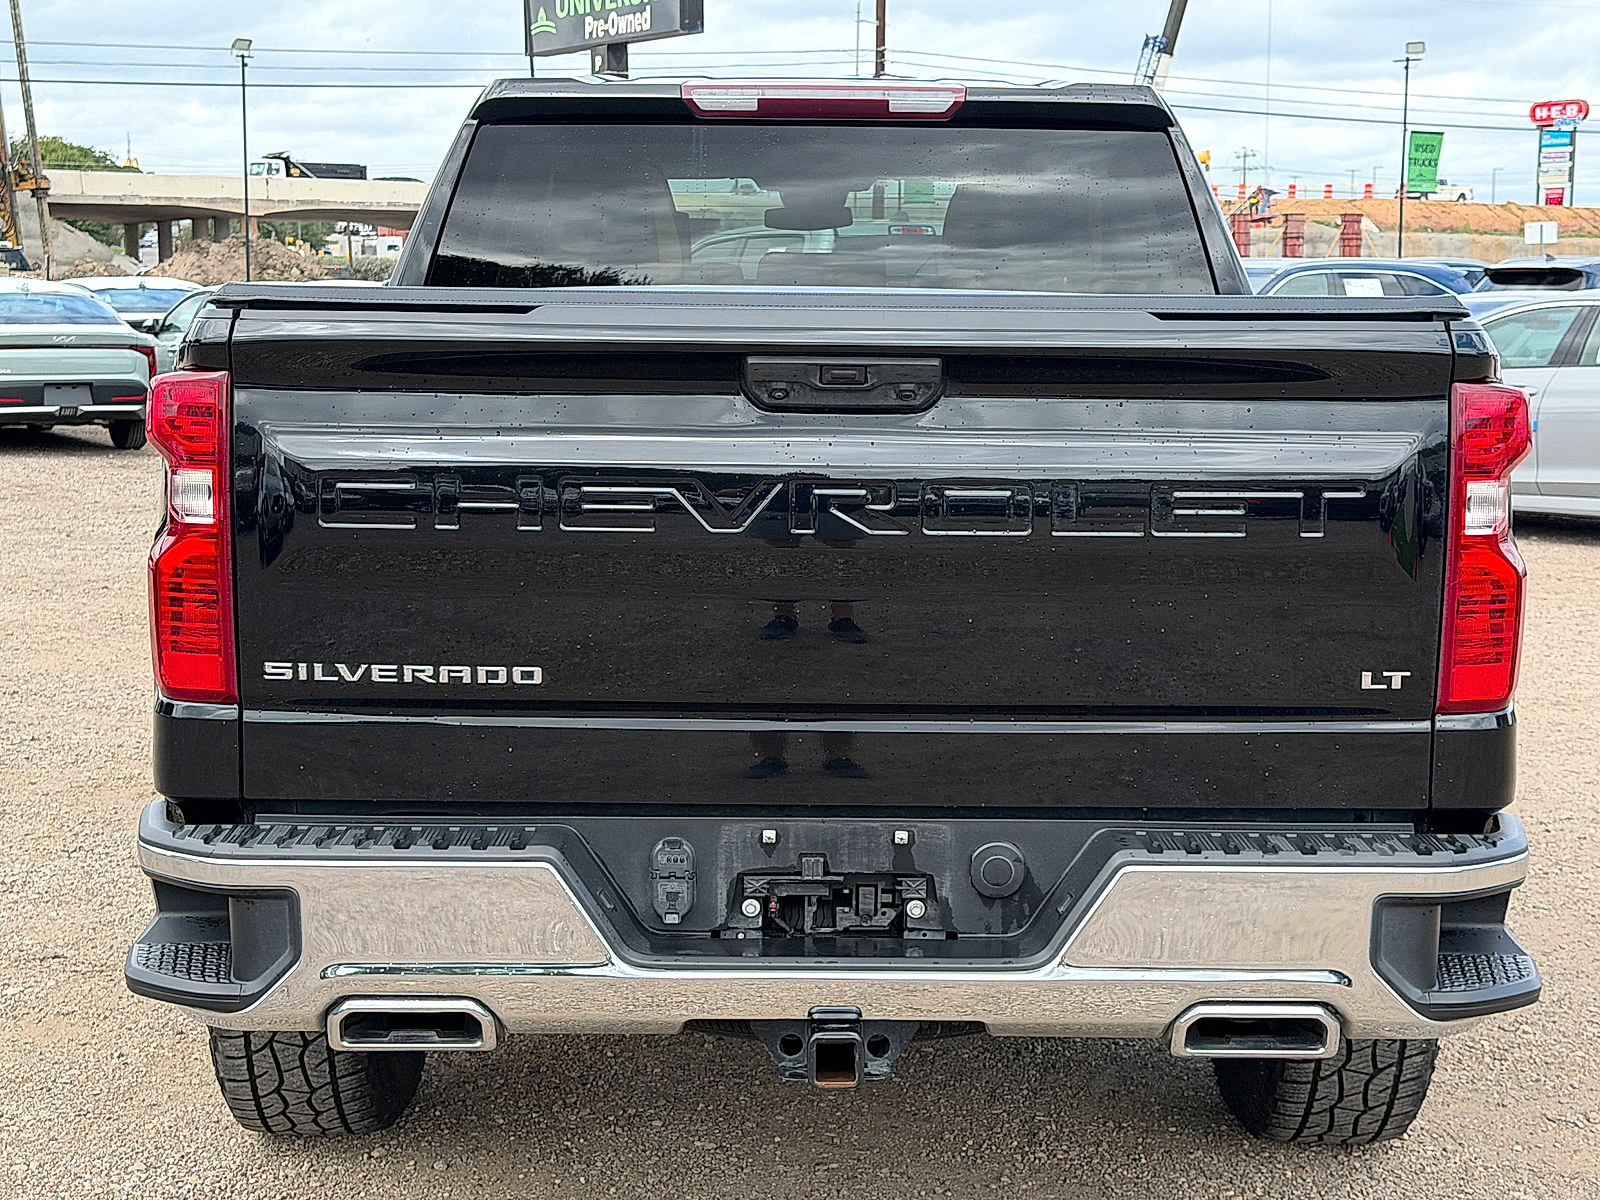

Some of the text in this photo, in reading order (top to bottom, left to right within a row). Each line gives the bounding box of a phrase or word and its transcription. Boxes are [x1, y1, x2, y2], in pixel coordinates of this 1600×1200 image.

[555, 0, 658, 18] UNIVE
[584, 5, 651, 39] Pre-Owned
[1414, 143, 1436, 154] USED
[1409, 157, 1438, 168] TRUCKS
[317, 474, 1367, 537] CHEVROLET
[263, 661, 544, 685] SILVERADO
[1361, 671, 1412, 689] LT
